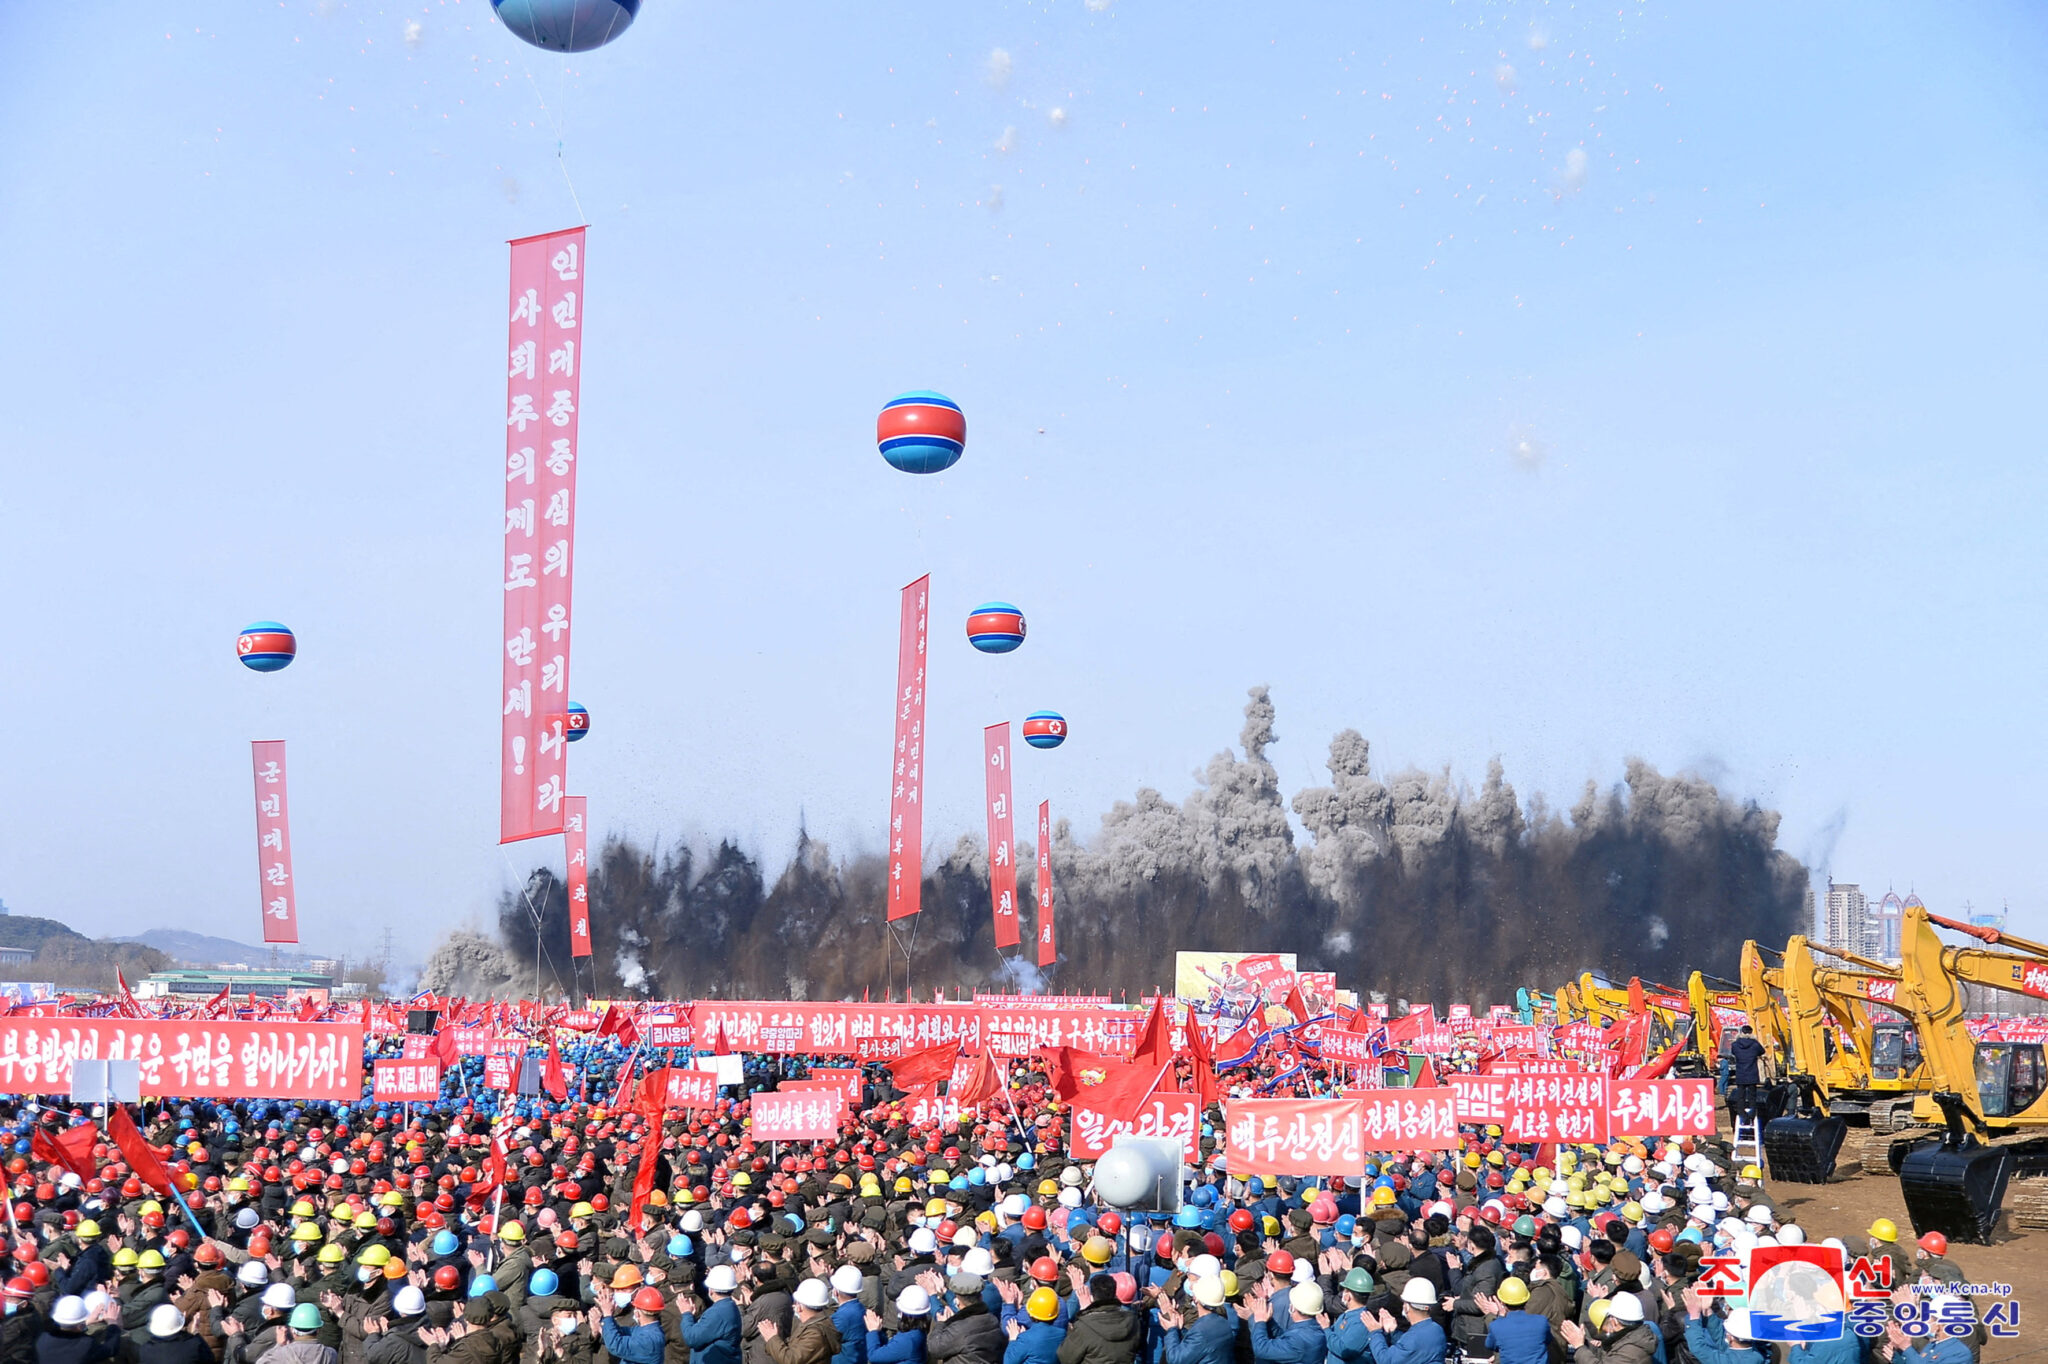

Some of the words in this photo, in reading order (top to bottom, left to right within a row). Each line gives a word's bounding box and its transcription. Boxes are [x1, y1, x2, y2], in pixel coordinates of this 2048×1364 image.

[543, 243, 578, 578] 인민대중중심의
[504, 288, 542, 591] 사회주의제도
[503, 626, 537, 776] 만세!
[537, 603, 569, 814] 우리나라
[900, 685, 912, 720] 모든
[258, 761, 289, 920] 군민대단결
[991, 745, 1013, 916] 이민위천
[567, 813, 588, 937] 결사관철
[653, 1026, 690, 1044] 결사옹위
[760, 1027, 803, 1040] 당중앙따라
[858, 1039, 901, 1058] 결사옹위
[992, 1034, 1029, 1056] 주체사상
[170, 1031, 233, 1086] 국면을
[241, 1032, 349, 1088] 열어나가자!
[668, 1075, 713, 1102] 백전백승
[1506, 1077, 1603, 1107] 사회주의건설의
[1610, 1079, 1713, 1127] 주체사상
[755, 1099, 833, 1131] 인민생활향상
[1231, 1112, 1359, 1162] 백두산정신
[1364, 1098, 1455, 1141] 정책옹위전
[1509, 1109, 1550, 1138] 새로운
